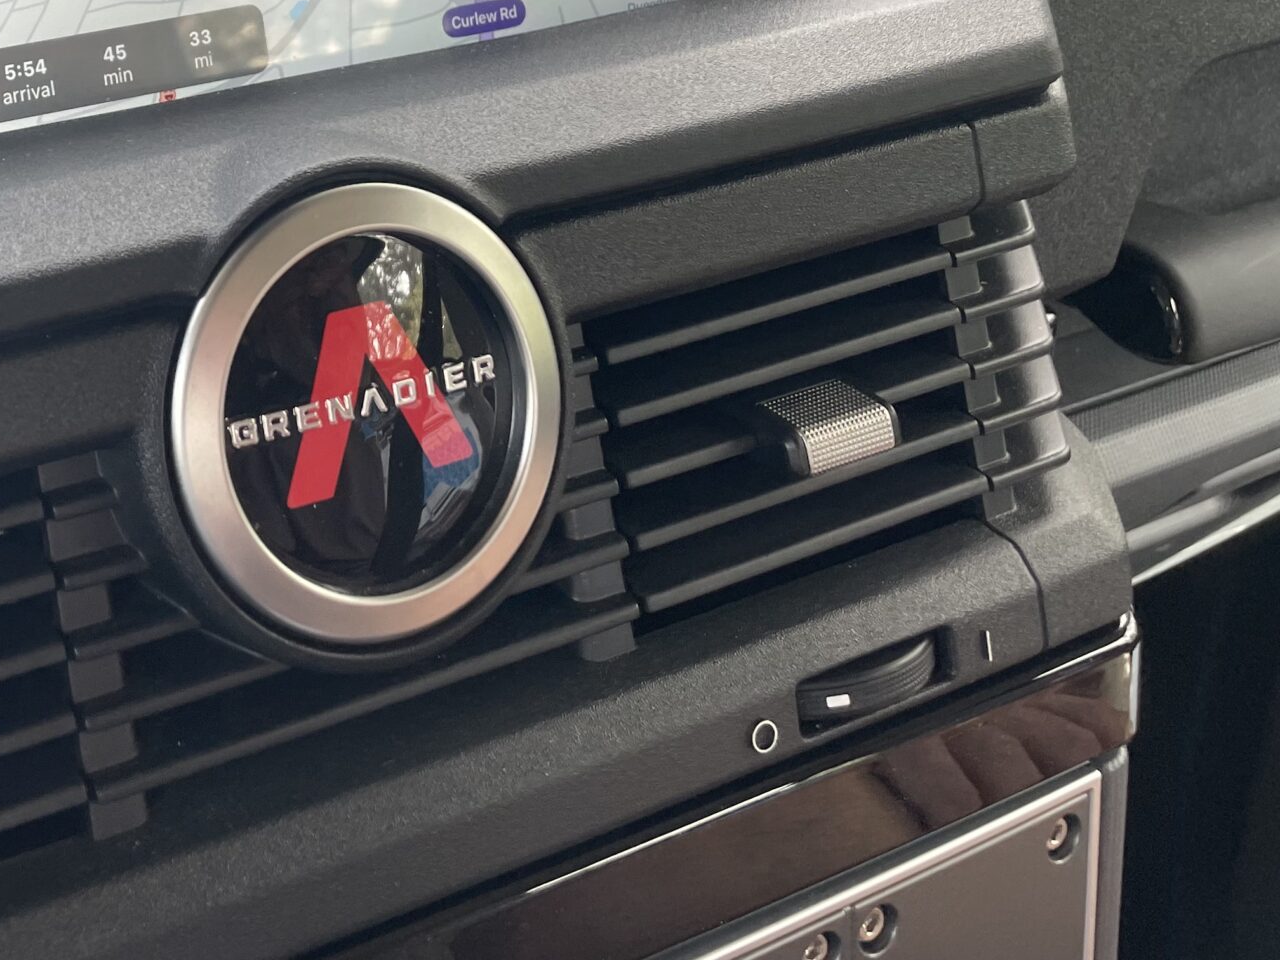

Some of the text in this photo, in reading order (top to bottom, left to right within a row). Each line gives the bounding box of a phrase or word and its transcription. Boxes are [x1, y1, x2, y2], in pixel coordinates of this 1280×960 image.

[451, 6, 518, 29] Curlew Rd
[189, 30, 213, 46] 33
[103, 45, 127, 62] 45
[194, 54, 214, 69] mi
[4, 59, 48, 81] 5:54
[103, 68, 133, 87] min
[2, 81, 56, 106] arrival
